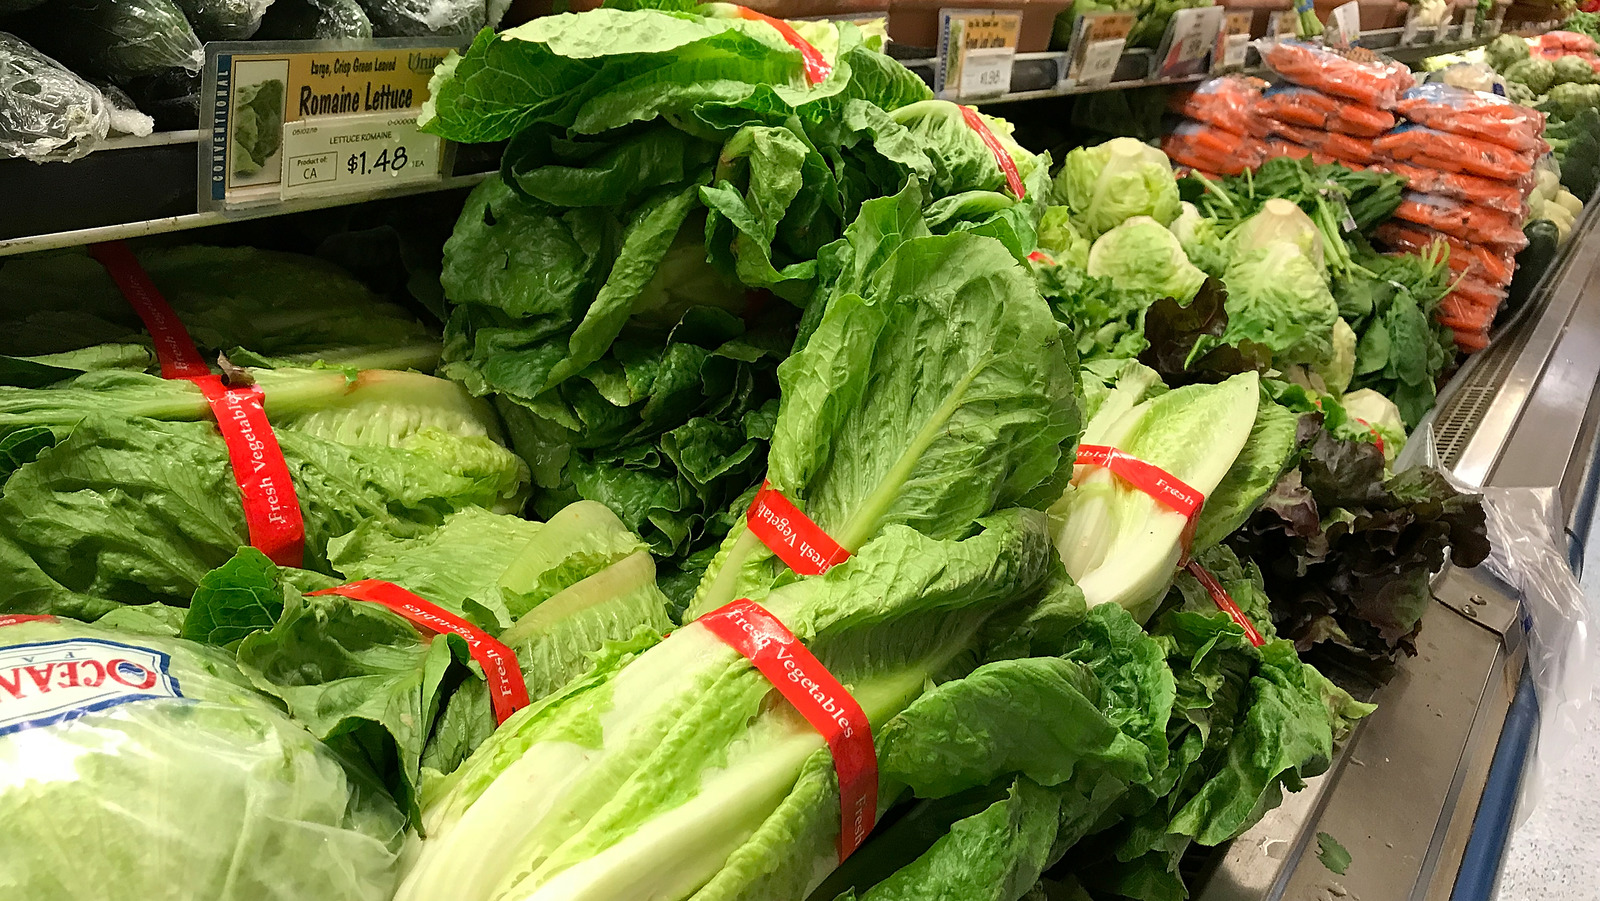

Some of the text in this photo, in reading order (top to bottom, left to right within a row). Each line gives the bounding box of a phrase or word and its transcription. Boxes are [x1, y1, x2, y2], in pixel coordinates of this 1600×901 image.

[310, 56, 397, 78] Large, Crisp Green Leaved
[299, 82, 413, 116] Romaine Lettuce
[212, 70, 229, 182] CONVENTIONAL
[329, 131, 392, 145] LETTUCE ROMAINE
[297, 156, 328, 167] Product of:
[303, 167, 317, 180] CA
[347, 145, 408, 175] $1.48
[164, 335, 189, 371] Fresh
[225, 390, 285, 524] Fresh Vegetables
[1155, 478, 1195, 506] Fresh
[402, 603, 512, 697] Fresh Vegetables
[725, 608, 868, 847] Fresh Vegetables Fresh
